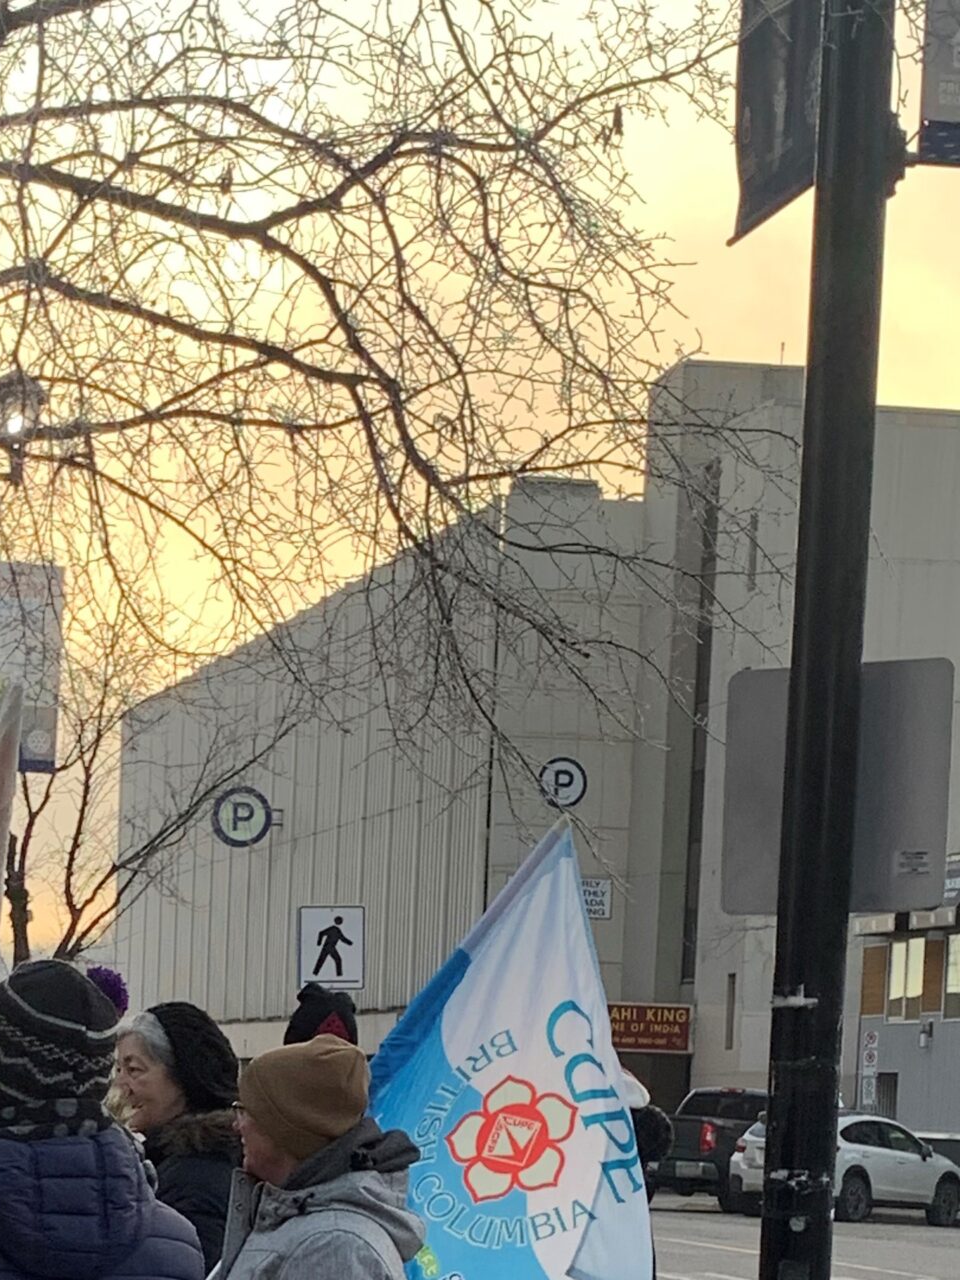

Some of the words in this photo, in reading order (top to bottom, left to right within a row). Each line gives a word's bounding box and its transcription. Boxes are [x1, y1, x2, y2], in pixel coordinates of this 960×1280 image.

[554, 769, 574, 796] P
[232, 802, 255, 831] P
[611, 1007, 637, 1020] AHI
[645, 1008, 688, 1023] KING
[630, 1023, 646, 1032] OF
[413, 1029, 518, 1164] BRITISH
[547, 1000, 643, 1204] CUPE
[412, 1173, 597, 1248] COLUMBIA
